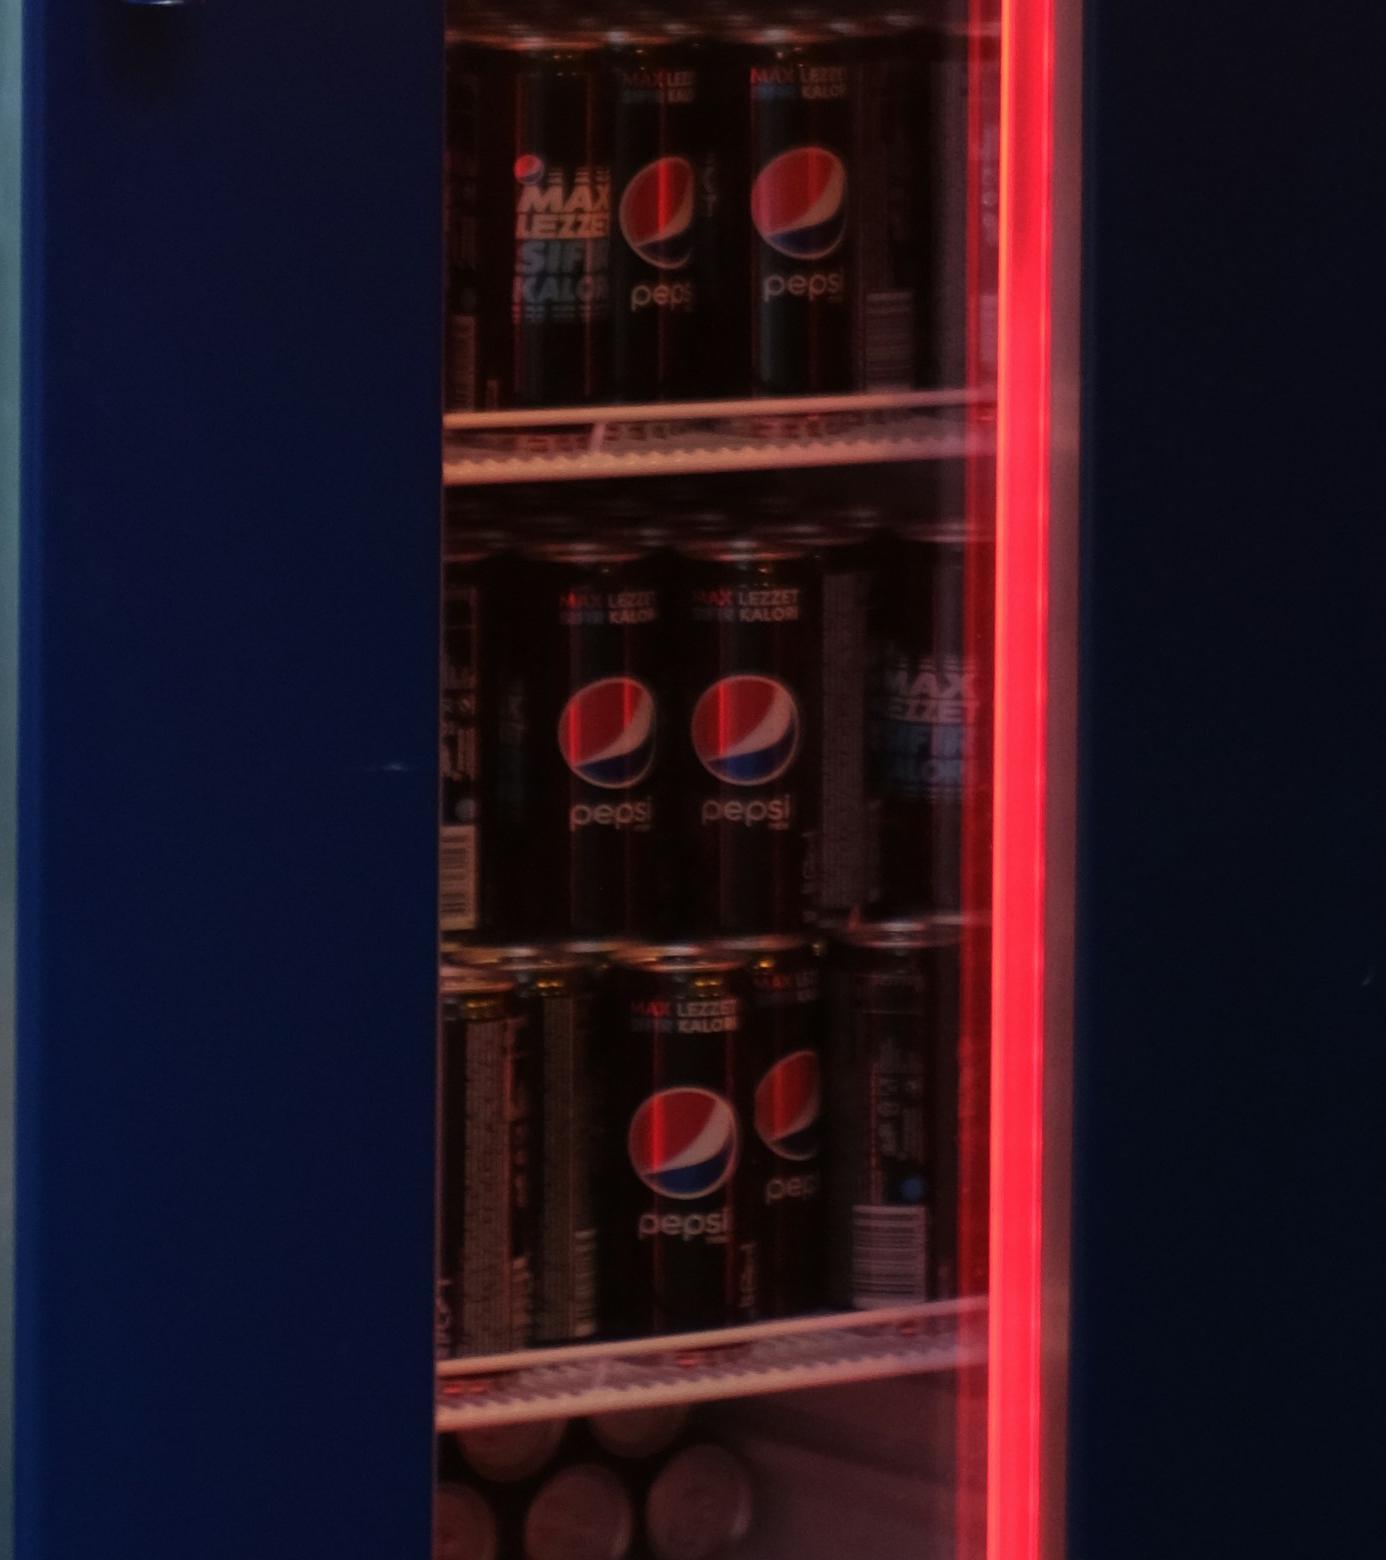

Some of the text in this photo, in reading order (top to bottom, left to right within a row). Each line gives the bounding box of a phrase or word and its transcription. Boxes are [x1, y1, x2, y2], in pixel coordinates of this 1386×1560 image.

[739, 587, 800, 607] LEZZET
[568, 795, 653, 830] pepsi
[700, 792, 792, 828] pepsi
[676, 998, 738, 1018] LEZZET
[638, 1205, 733, 1243] pepsi
